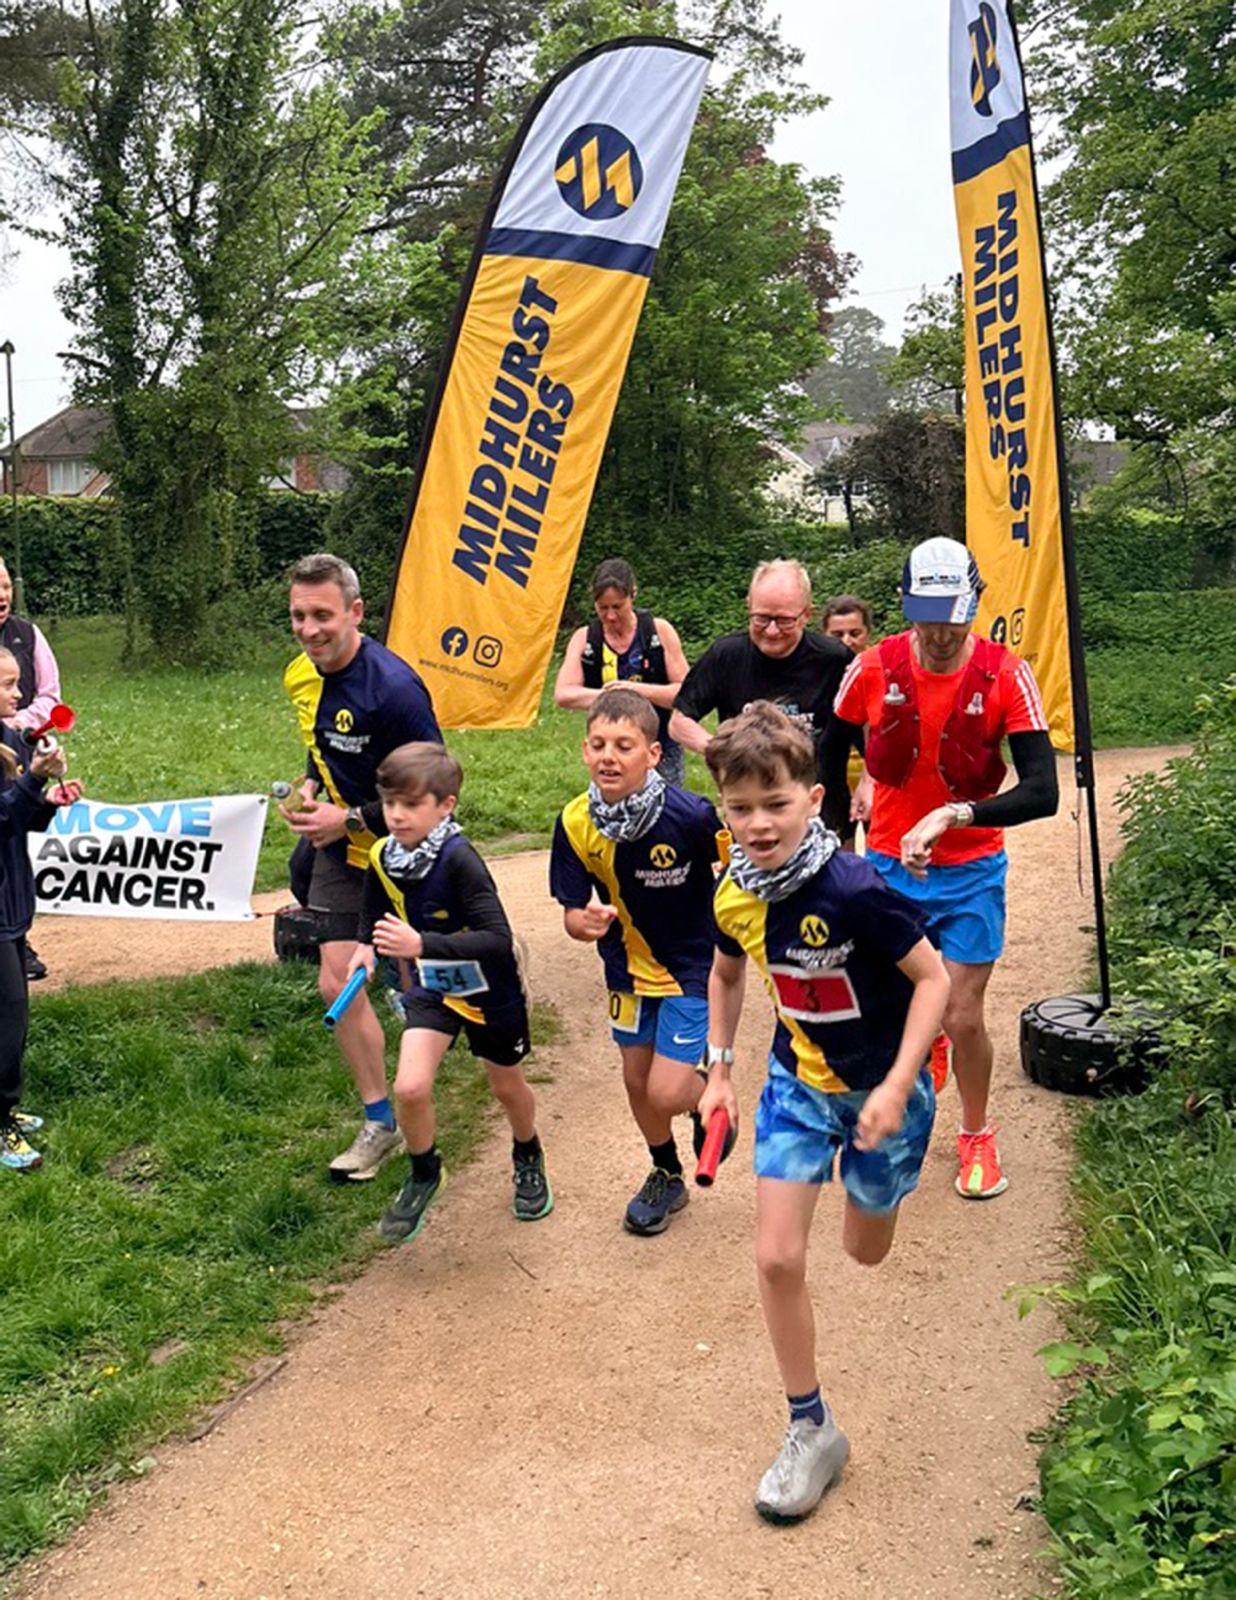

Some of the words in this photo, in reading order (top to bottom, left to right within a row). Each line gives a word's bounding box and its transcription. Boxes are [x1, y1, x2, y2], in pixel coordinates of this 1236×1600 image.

[974, 225, 1006, 460] MILERS
[997, 190, 1031, 548] MIDHURST
[452, 275, 558, 585] MIDHURST
[494, 374, 574, 589] MILERS
[46, 799, 213, 837] MOVE
[36, 834, 223, 874] AGAINST
[35, 866, 216, 911] CANCER.
[434, 968, 468, 992] 54
[799, 979, 821, 1014] 3
